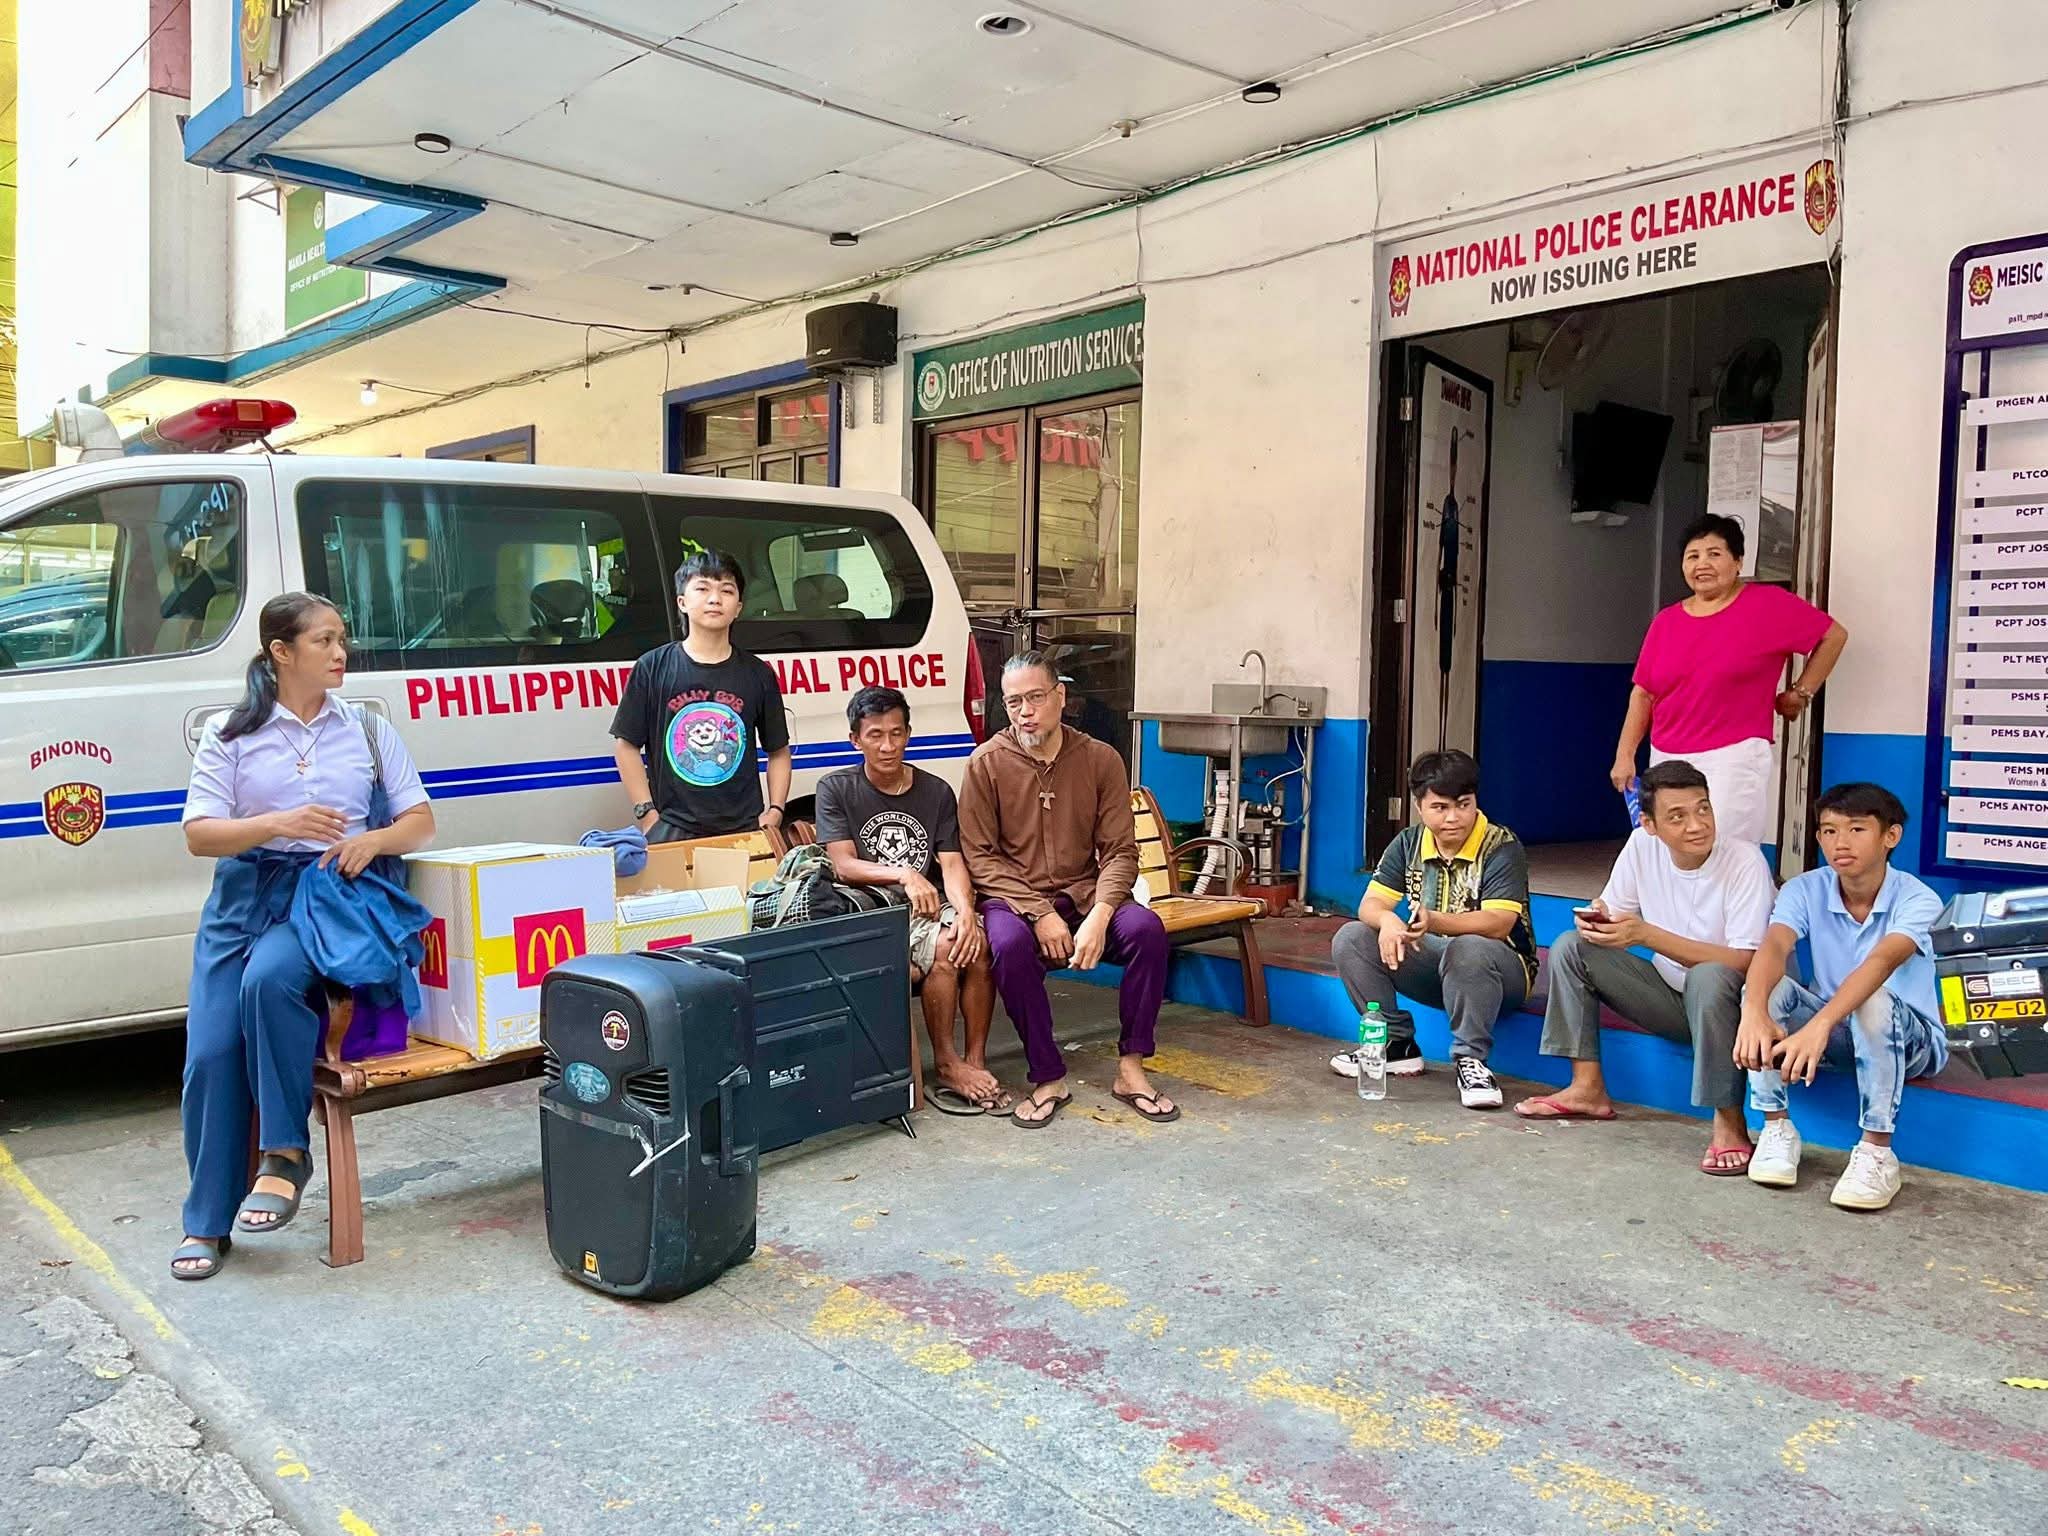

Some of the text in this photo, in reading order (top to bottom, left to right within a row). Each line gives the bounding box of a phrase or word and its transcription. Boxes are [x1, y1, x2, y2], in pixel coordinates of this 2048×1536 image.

[1416, 233, 1526, 287] NATIONAL
[1534, 211, 1622, 262] POLICE
[1630, 173, 1795, 242] CLEARANCE
[1490, 242, 1697, 304] NOW ISSUING HERE
[1997, 262, 2043, 288] MEISIC
[949, 357, 988, 400] OFFICE
[990, 351, 1007, 392] OF
[1010, 335, 1083, 387] NUTRITION
[1996, 396, 2034, 408] PMGEN
[2012, 469, 2048, 480] PLTCO
[2016, 507, 2044, 517] PCPT
[1998, 545, 2025, 554] PCPT
[1991, 581, 2046, 591] PCPT TOM
[1995, 618, 2047, 627] PCPT JOS
[2003, 655, 2022, 663] PLT
[837, 653, 946, 692] POLICE
[2011, 692, 2040, 701] PSMS
[1991, 729, 2048, 738] PEMS BAY
[30, 740, 113, 770] BINONDO
[2004, 766, 2033, 775] PEMS
[2007, 778, 2038, 787] Women
[1980, 801, 2008, 811] PCMS
[862, 813, 924, 836] THE WORLDWIDE
[1983, 838, 2013, 848] PCMS
[1973, 1000, 2043, 1019] 97-02
